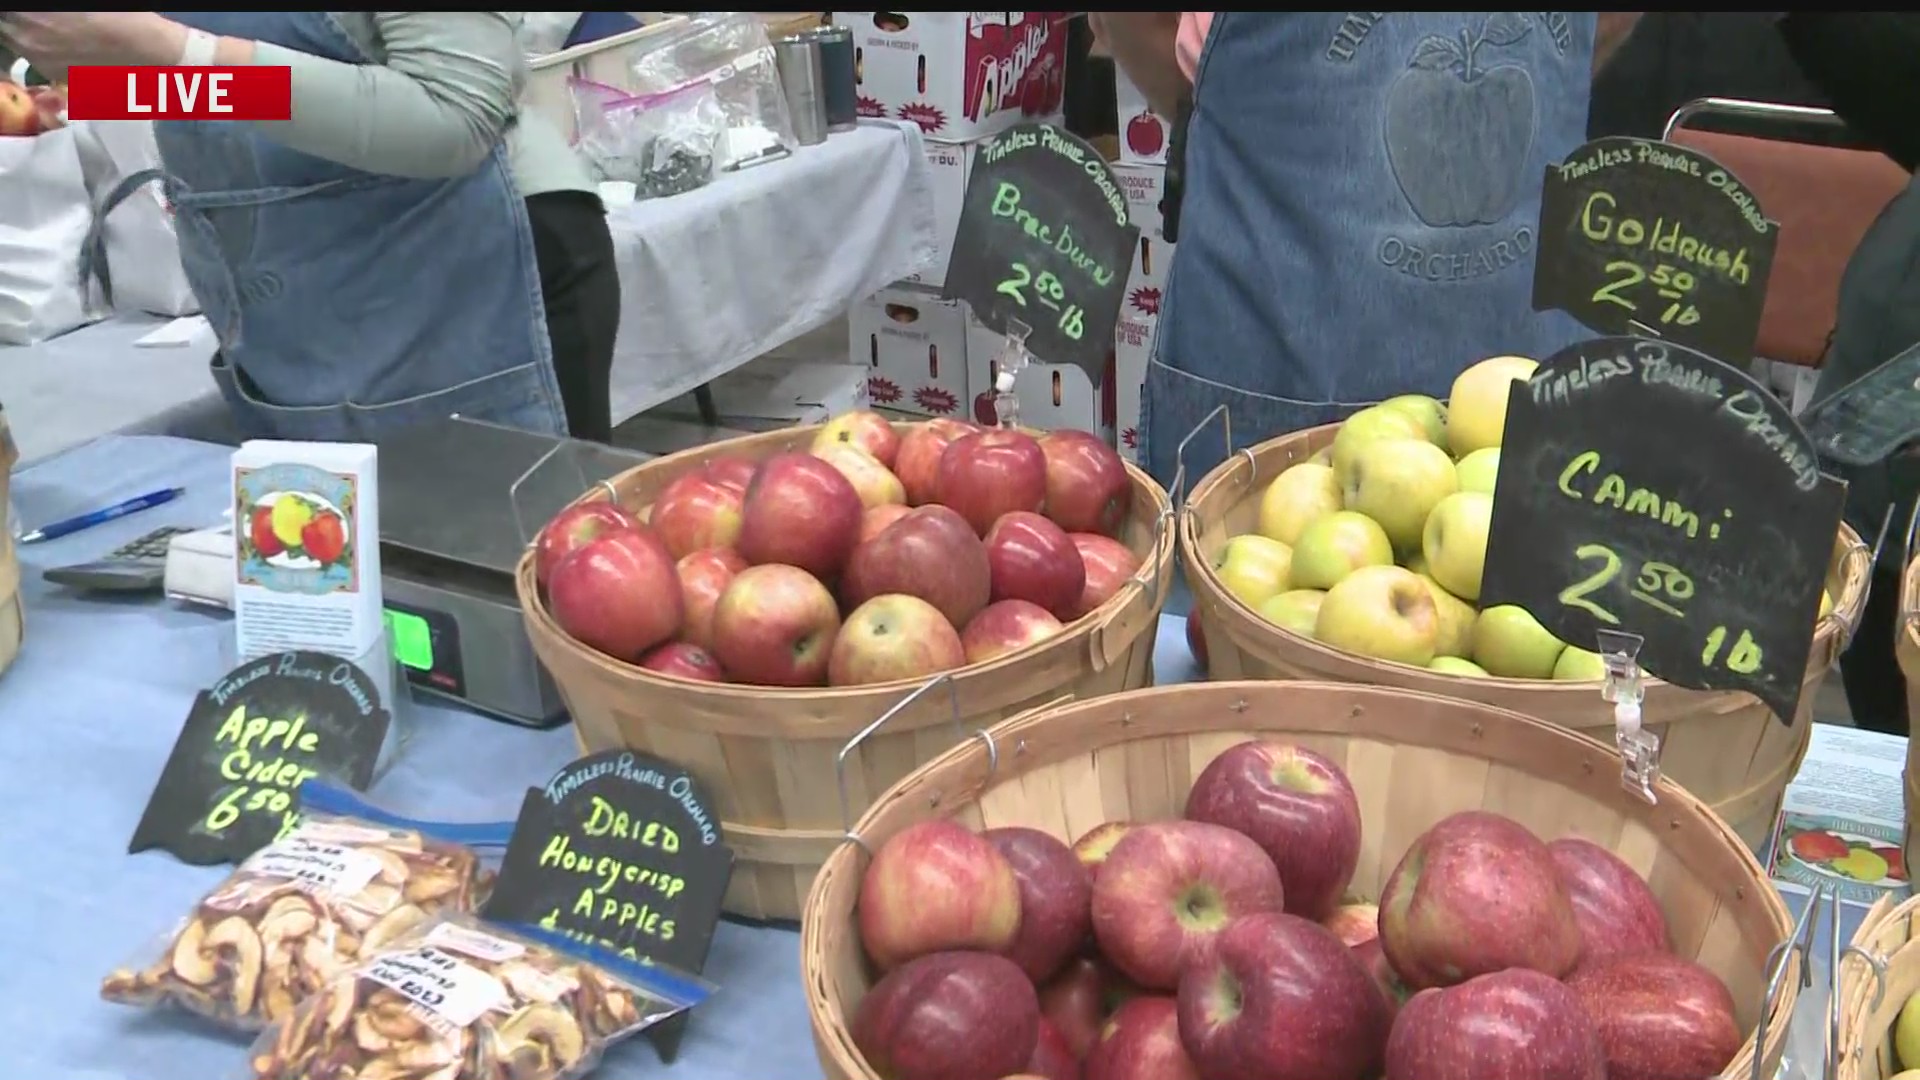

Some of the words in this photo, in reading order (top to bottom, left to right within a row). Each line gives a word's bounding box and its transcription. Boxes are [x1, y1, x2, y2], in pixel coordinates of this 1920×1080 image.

[970, 17, 1050, 124] Apples
[1377, 226, 1535, 281] ORCHARD
[214, 704, 320, 752] Apple
[221, 749, 319, 789] Cider
[581, 796, 681, 854] DRIED
